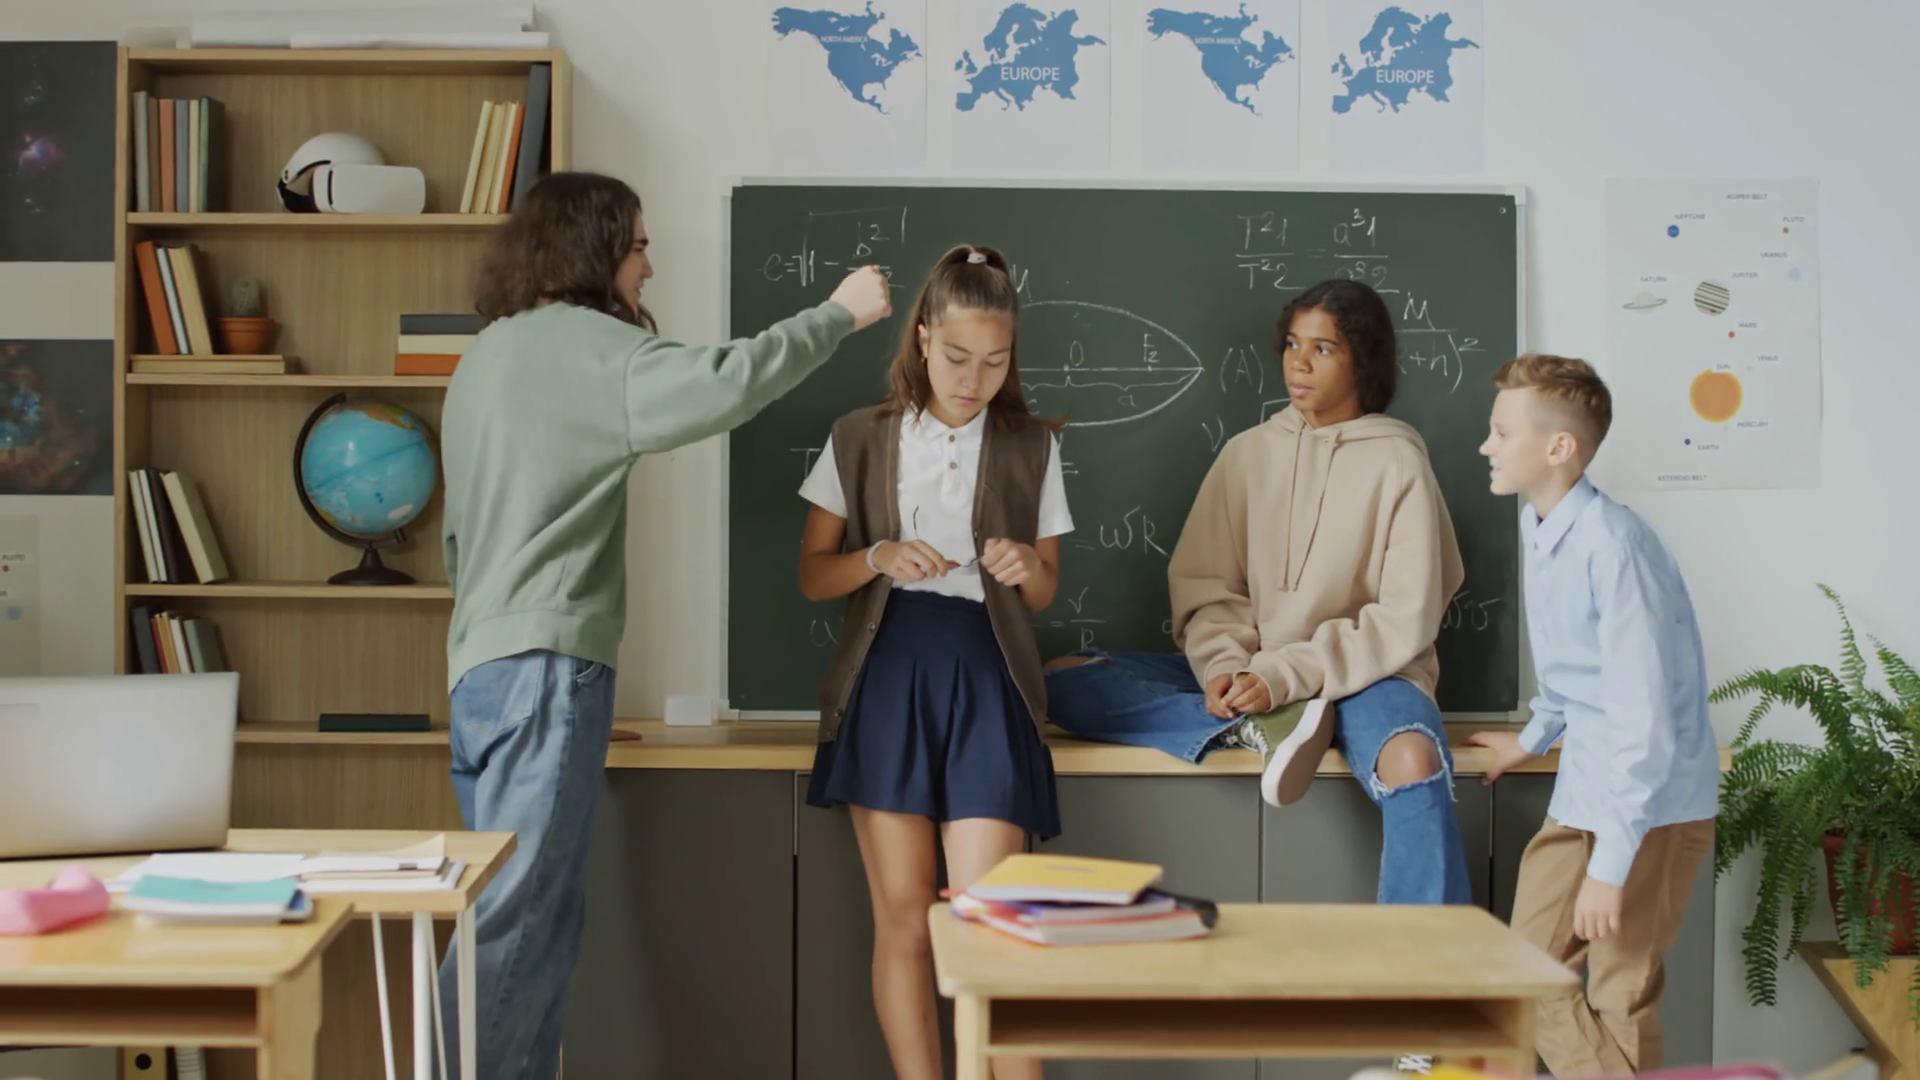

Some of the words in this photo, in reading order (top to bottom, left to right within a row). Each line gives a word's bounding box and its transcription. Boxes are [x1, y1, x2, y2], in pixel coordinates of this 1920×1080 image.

[821, 35, 841, 43] NORTH
[842, 35, 868, 43] AMERICA
[1001, 66, 1060, 81] EUROPE
[1376, 69, 1435, 84] EUROPE
